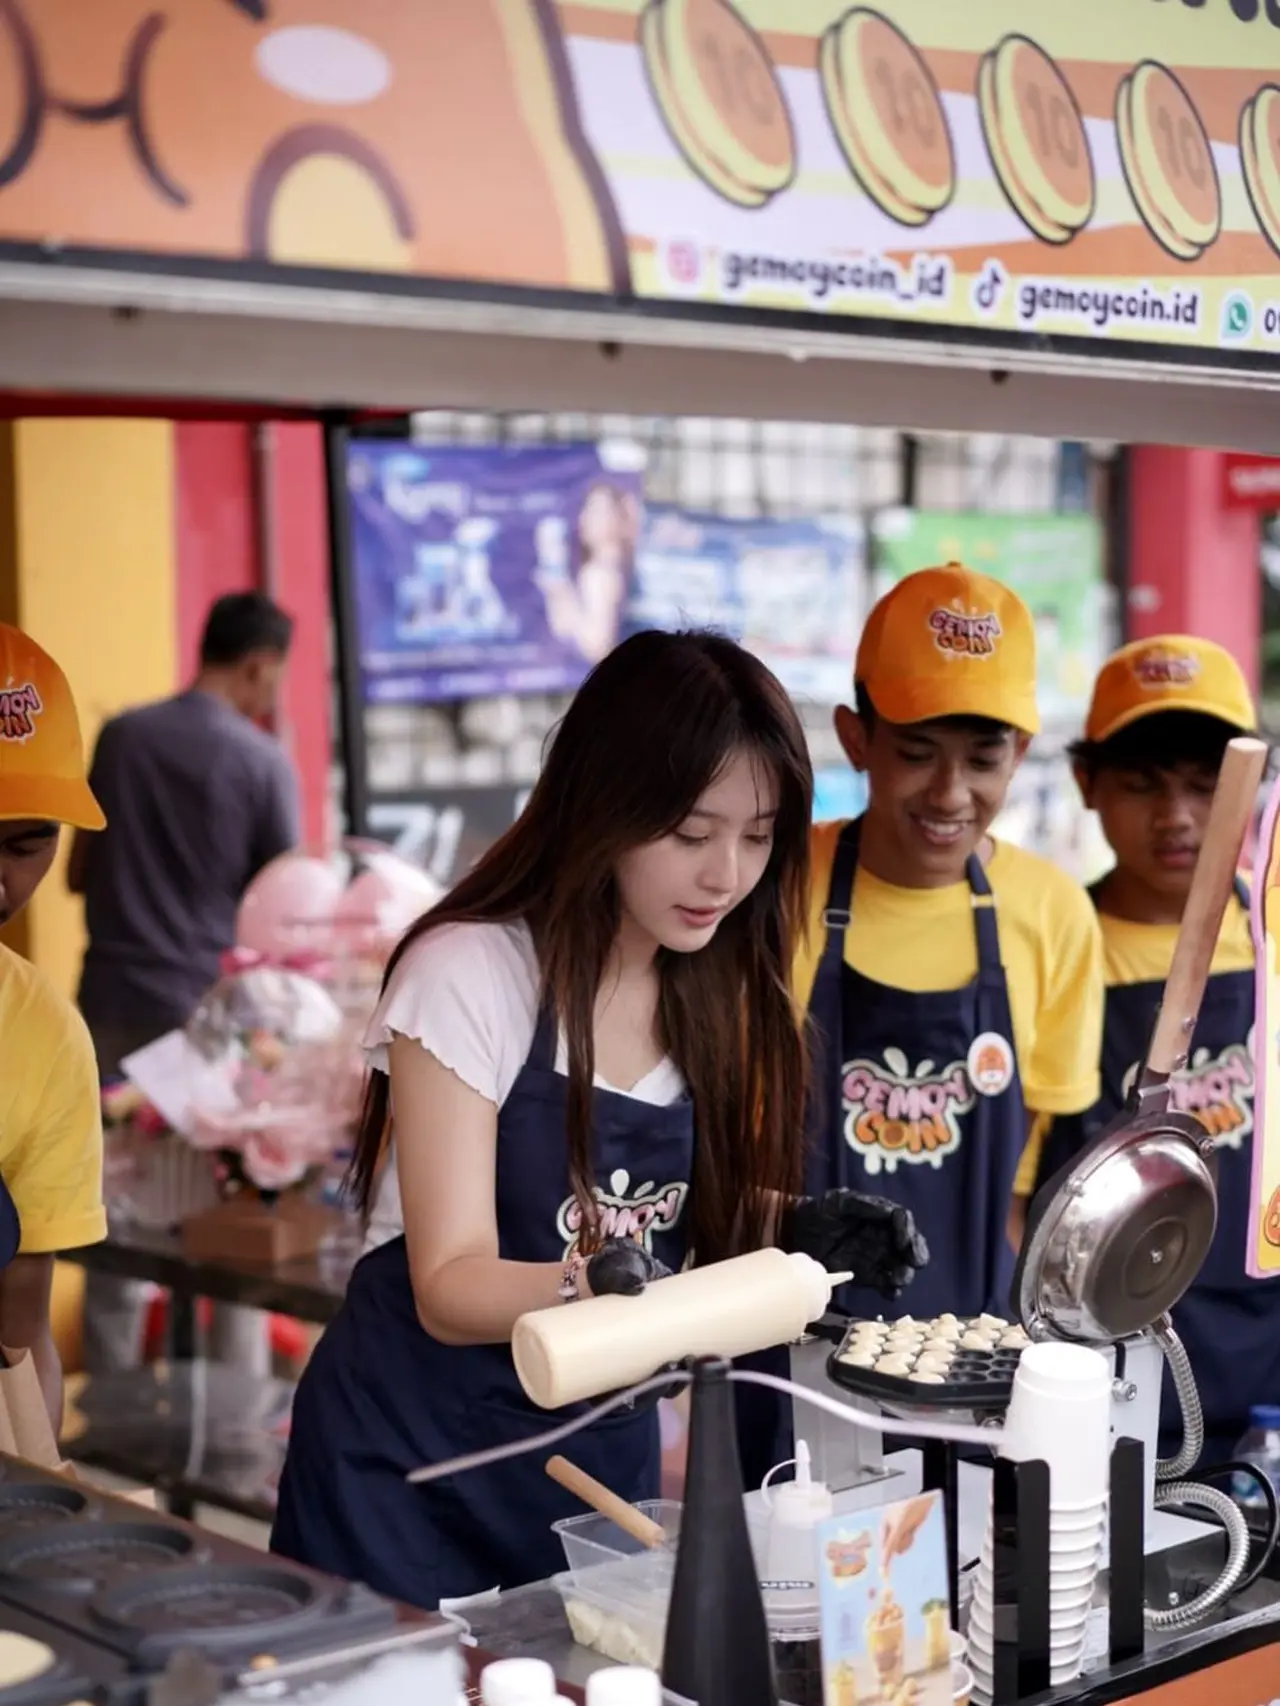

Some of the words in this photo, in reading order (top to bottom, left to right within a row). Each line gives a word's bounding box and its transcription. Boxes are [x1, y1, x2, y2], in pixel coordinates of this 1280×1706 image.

[1026, 81, 1080, 170] 10
[1156, 104, 1206, 190] 10
[724, 252, 947, 301] gemoycoin_id
[1020, 284, 1198, 326] gemoycoin.id
[1263, 307, 1280, 338] 0
[930, 610, 1001, 637] GEMOY
[938, 633, 992, 655] COIN
[842, 1066, 972, 1120] GEMOY
[855, 1110, 952, 1154] COIN
